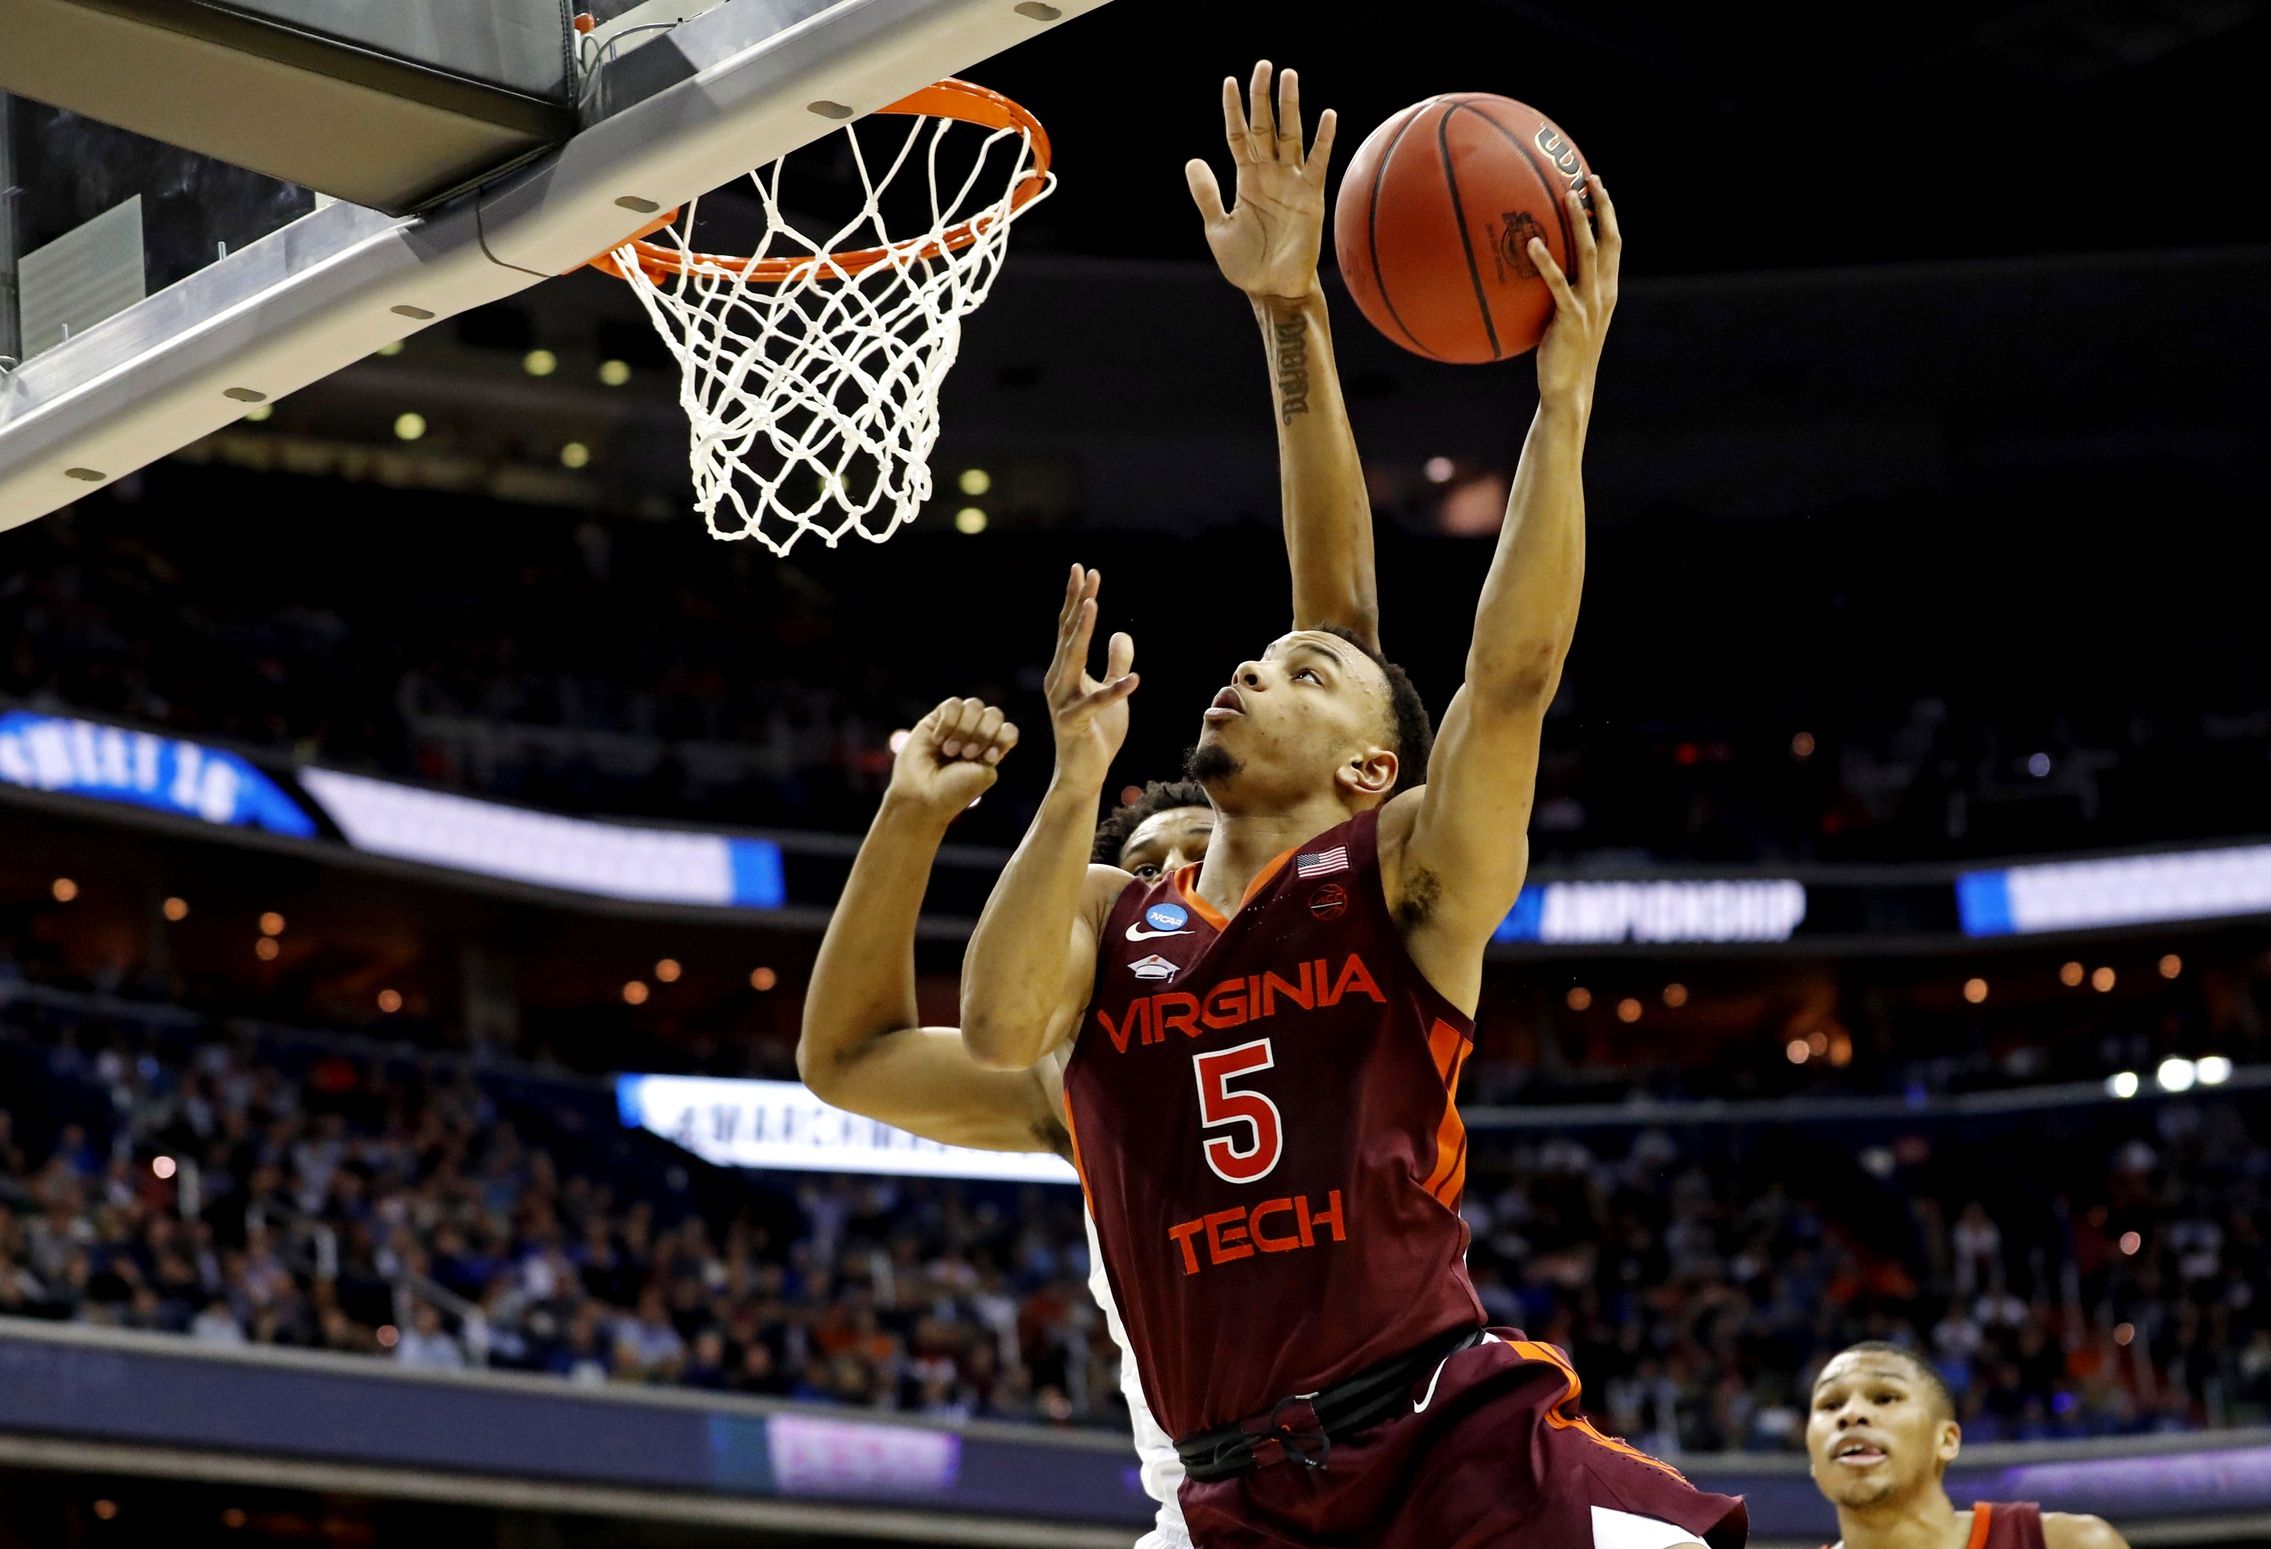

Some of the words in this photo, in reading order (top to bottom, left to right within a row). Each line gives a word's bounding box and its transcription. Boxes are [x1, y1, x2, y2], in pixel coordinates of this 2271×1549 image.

[1150, 911, 1183, 926] NCAA
[1098, 954, 1387, 1053] VIRGINIA
[1193, 1038, 1282, 1183] 5
[1169, 1190, 1346, 1275] TECH
